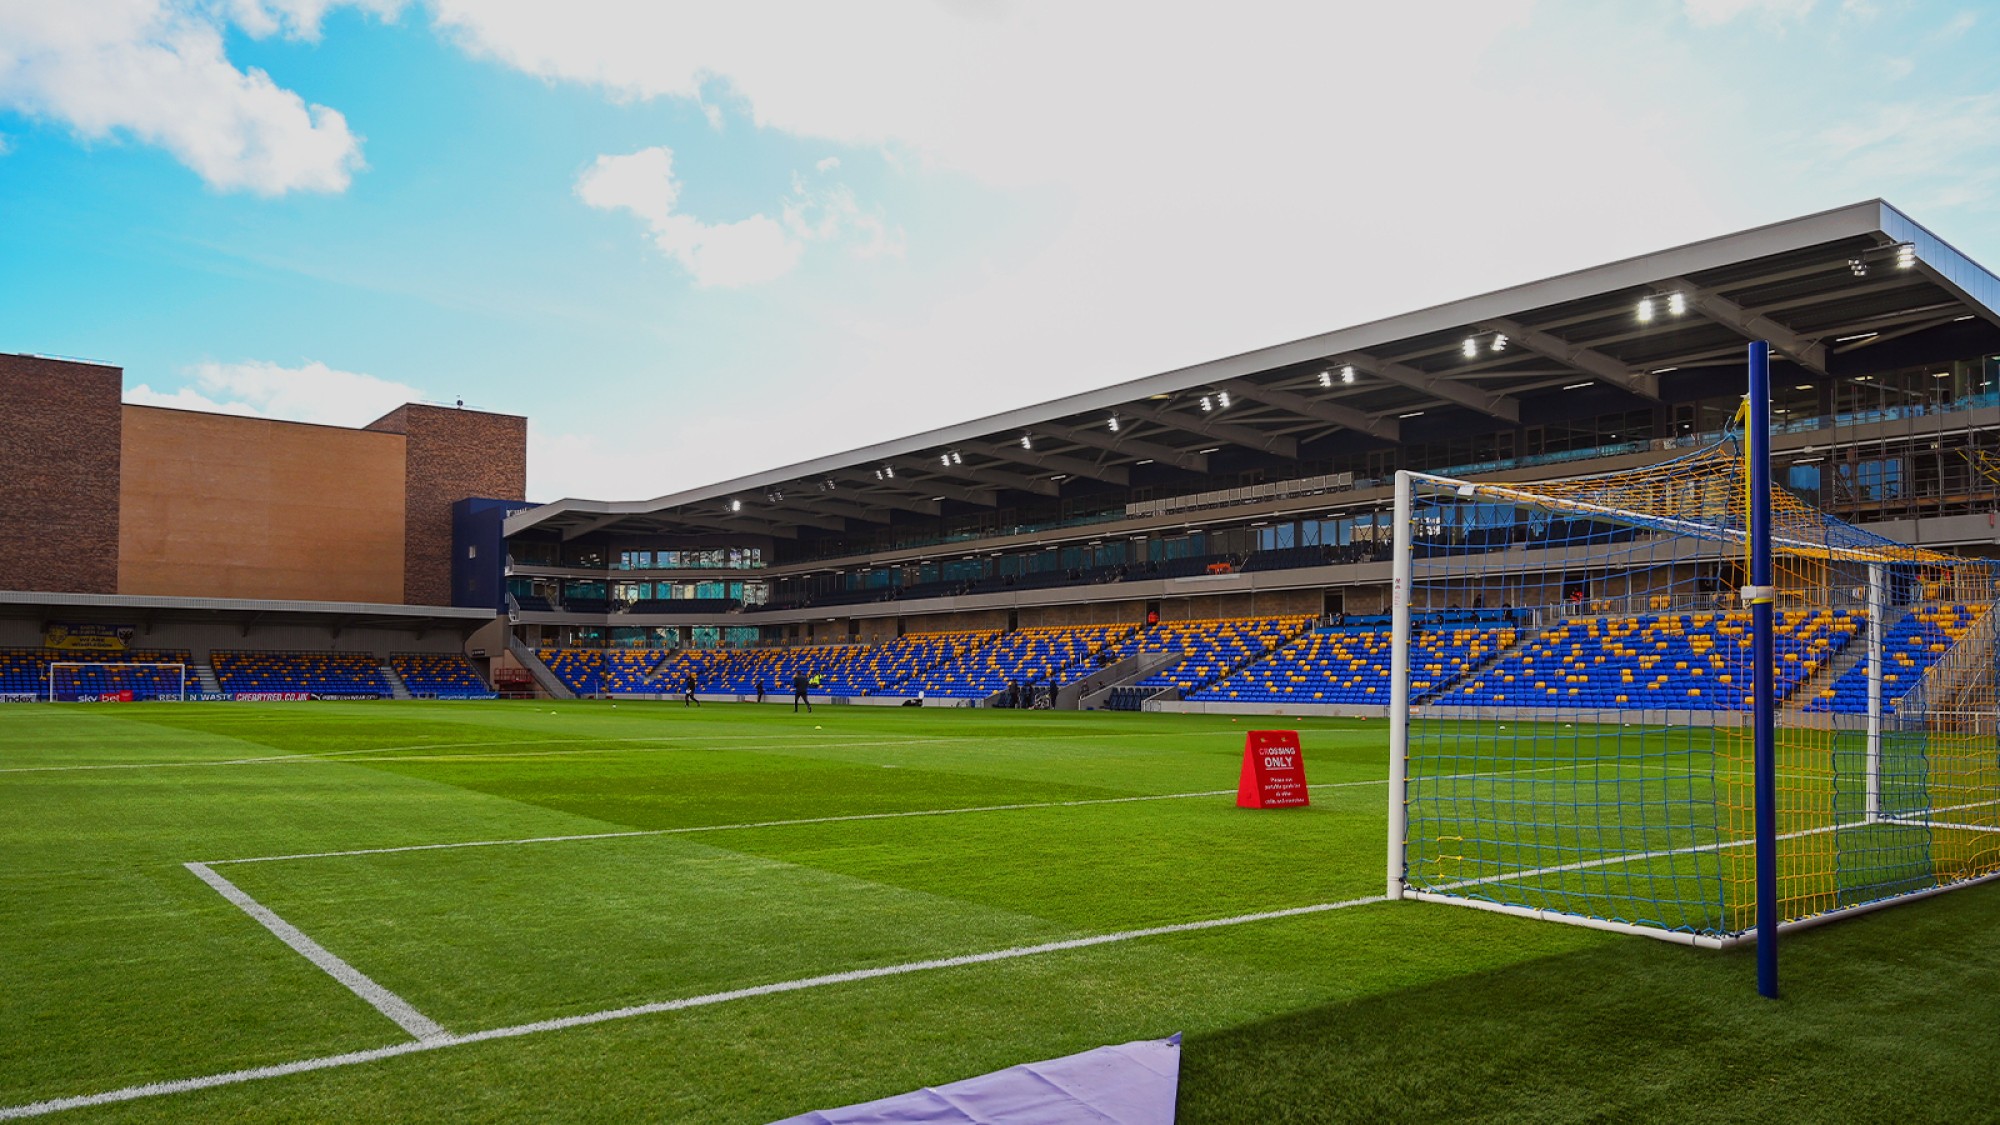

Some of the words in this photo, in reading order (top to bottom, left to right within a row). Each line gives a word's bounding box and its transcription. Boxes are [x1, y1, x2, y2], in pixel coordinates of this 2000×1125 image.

[4, 694, 32, 703] Index
[78, 694, 98, 703] sky
[102, 694, 120, 703] bet
[201, 693, 233, 701] WASTE
[1259, 746, 1296, 756] CROSSING
[1264, 756, 1293, 767] ONLY
